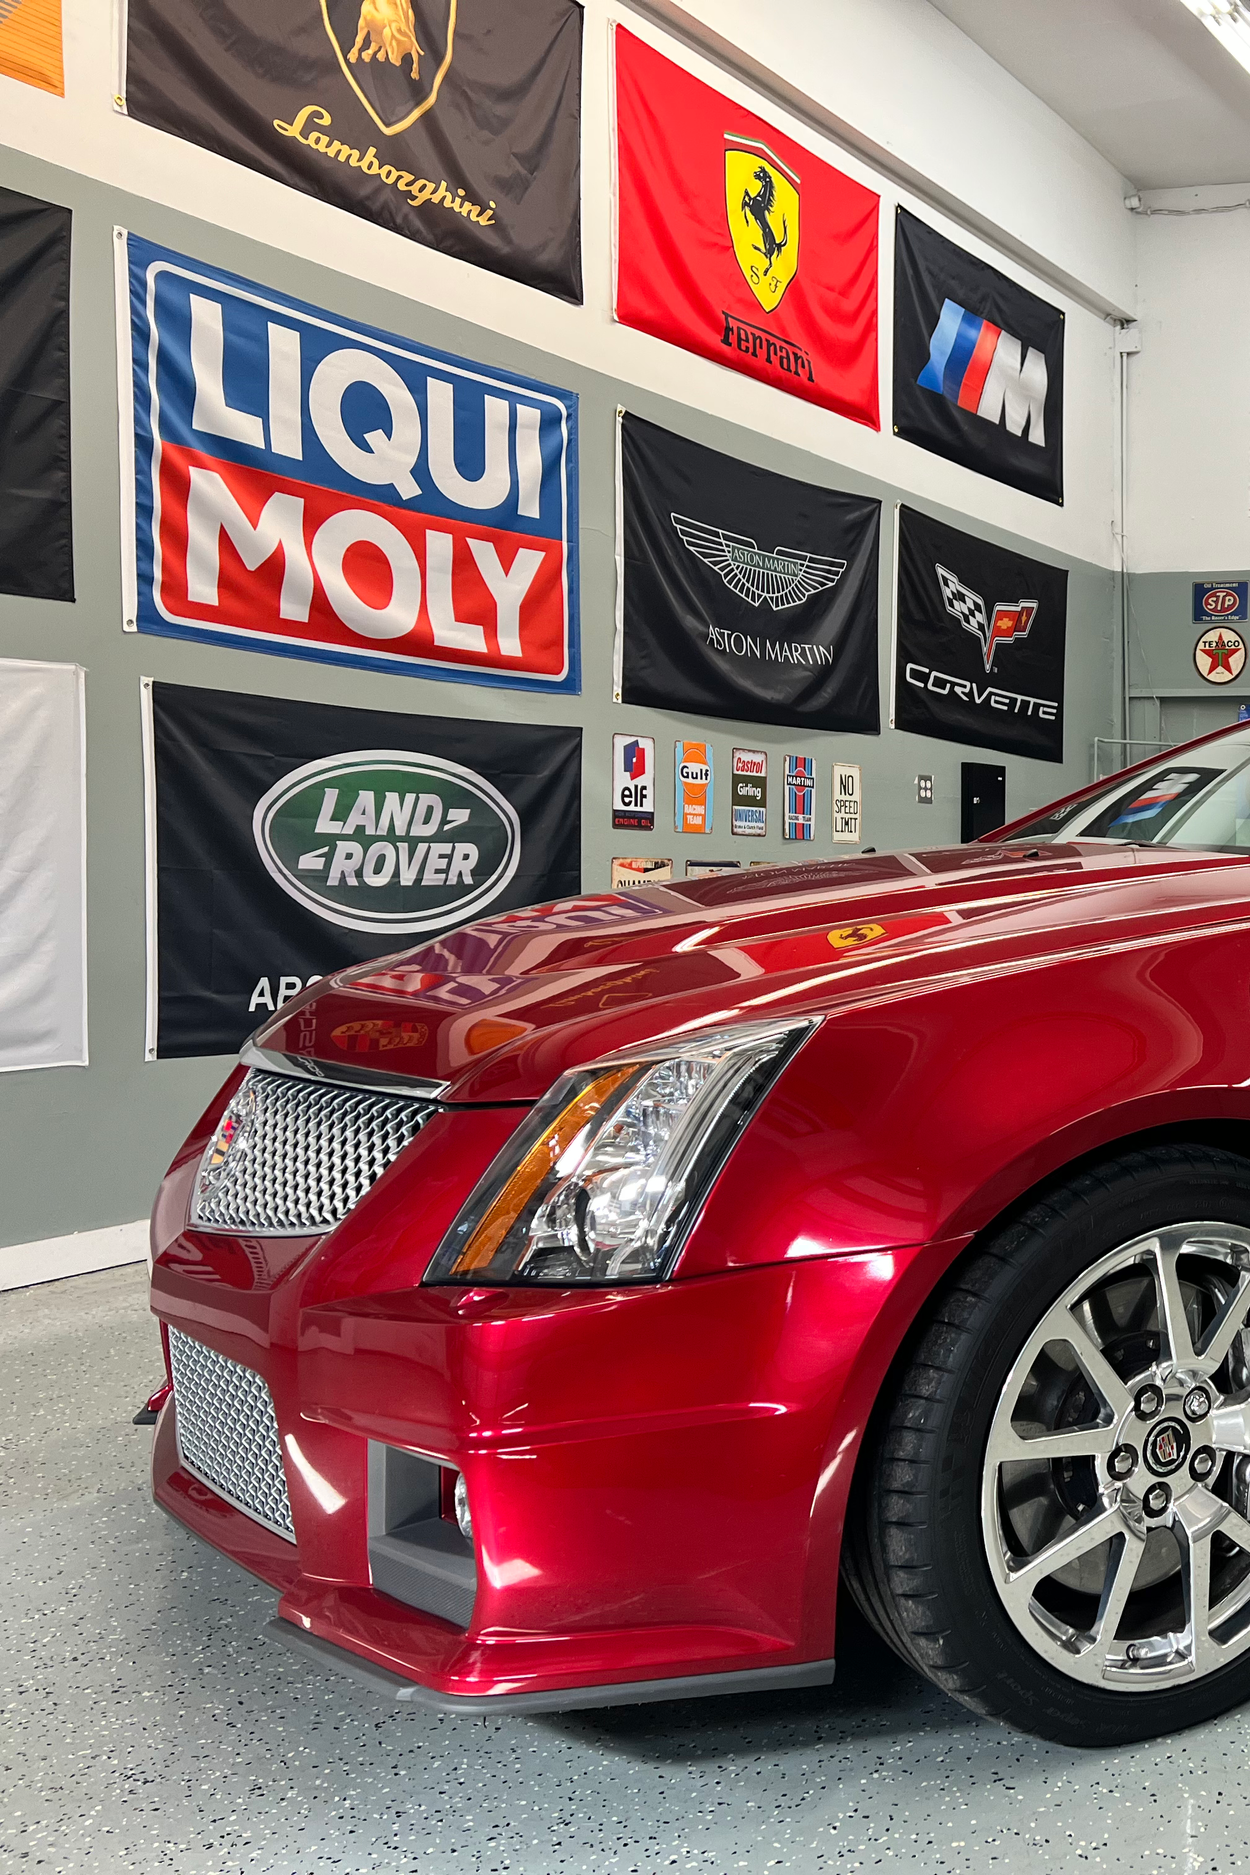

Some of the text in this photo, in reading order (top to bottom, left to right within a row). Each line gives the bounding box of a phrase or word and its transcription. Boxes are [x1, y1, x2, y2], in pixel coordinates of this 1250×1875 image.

[272, 104, 497, 226] Lamborghini
[750, 265, 760, 285] S
[721, 310, 815, 383] Ferrari
[189, 293, 541, 519] LIQUI
[186, 464, 546, 657] MOLY
[732, 548, 798, 575] ASTON MARTIN
[1207, 592, 1234, 611] STP
[706, 624, 833, 665] ASTON MARTIN
[1202, 640, 1240, 648] TEXACO
[905, 662, 1058, 720] CORVETTE
[680, 765, 709, 781] Gulf
[736, 757, 764, 774] Castrol
[737, 783, 761, 800] Girling
[787, 776, 814, 787] MARTINI
[839, 774, 854, 796] NO
[621, 784, 647, 807] elf
[313, 787, 443, 837] LAND
[734, 808, 764, 824] UNIVERSAL
[835, 799, 858, 815] SPEED
[835, 817, 858, 833] LIMIT
[326, 840, 479, 888] ROVER
